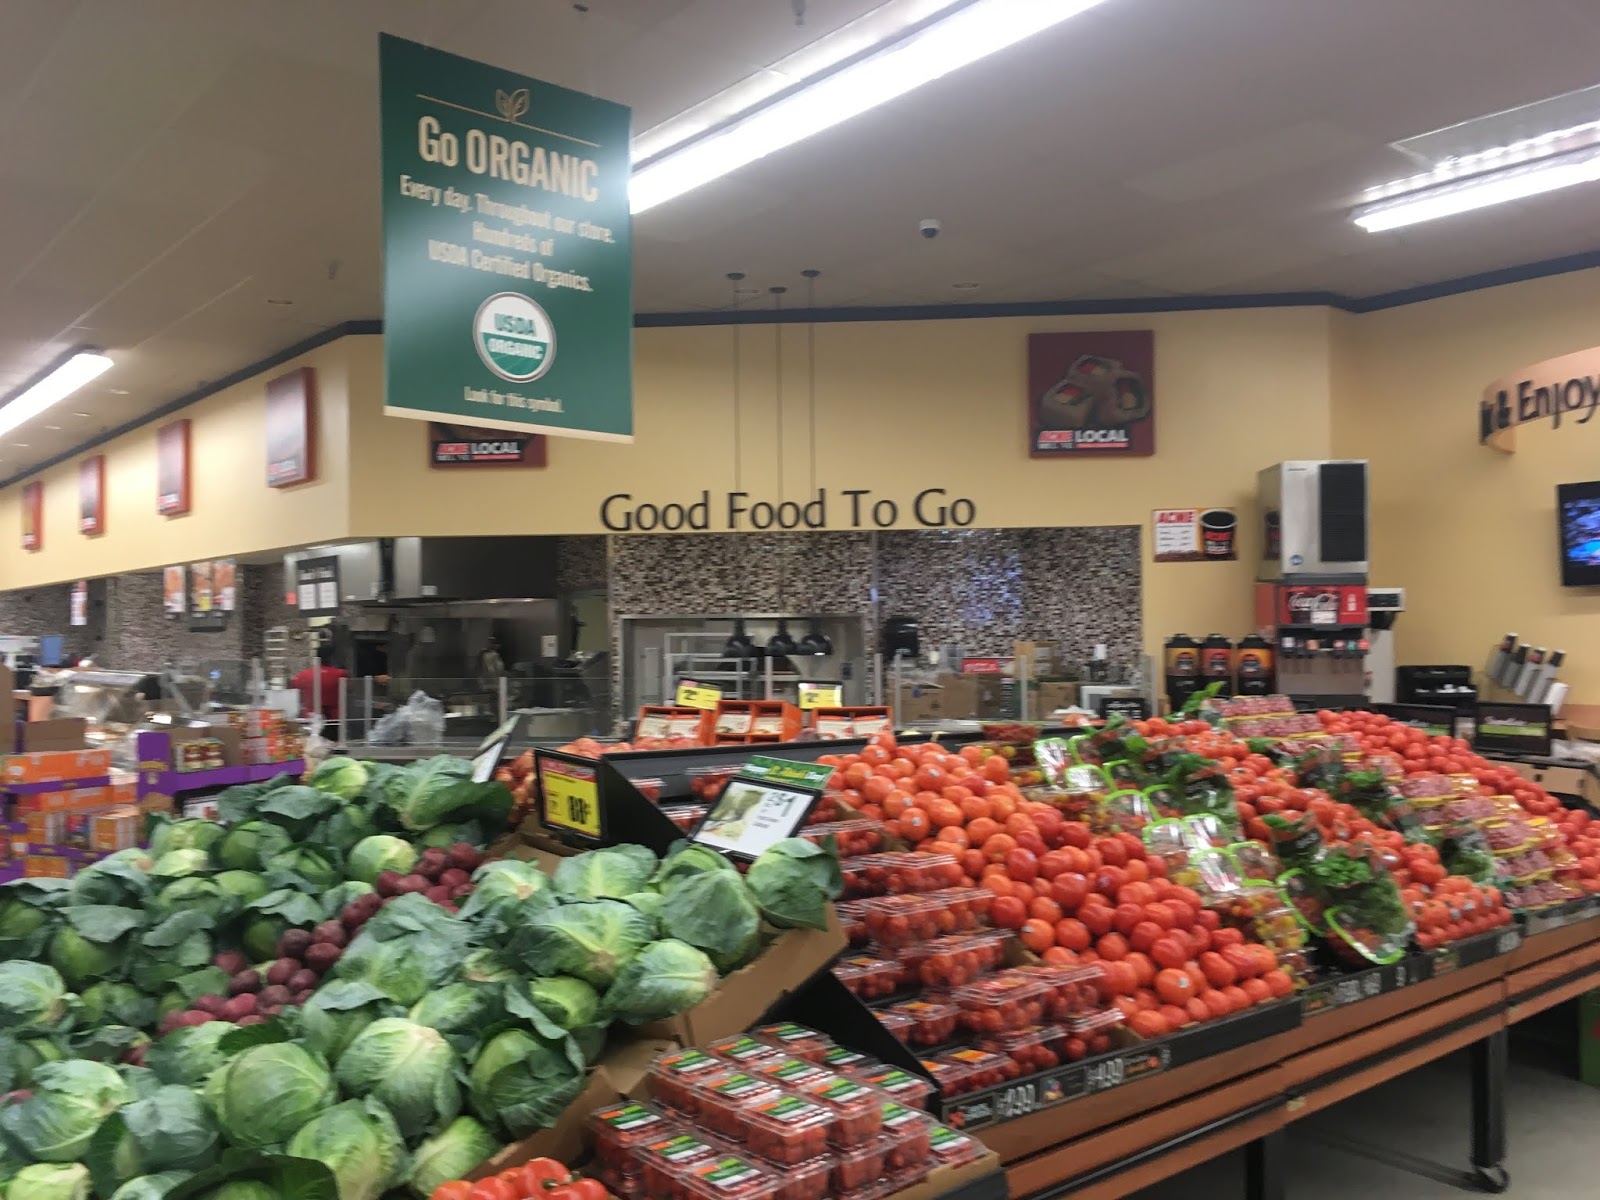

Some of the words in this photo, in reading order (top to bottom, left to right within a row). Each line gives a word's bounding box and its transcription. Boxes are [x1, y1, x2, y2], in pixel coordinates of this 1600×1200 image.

[418, 115, 459, 167] Go
[465, 129, 599, 203] ORGANIC
[400, 175, 442, 206] Every
[494, 313, 537, 337] USDA
[488, 338, 544, 360] ORGANIC
[1074, 429, 1129, 443] LOCAL
[470, 442, 520, 455] LOCAL
[600, 490, 710, 532] Good
[727, 488, 827, 530] Food
[841, 489, 898, 528] To
[914, 488, 977, 528] Go
